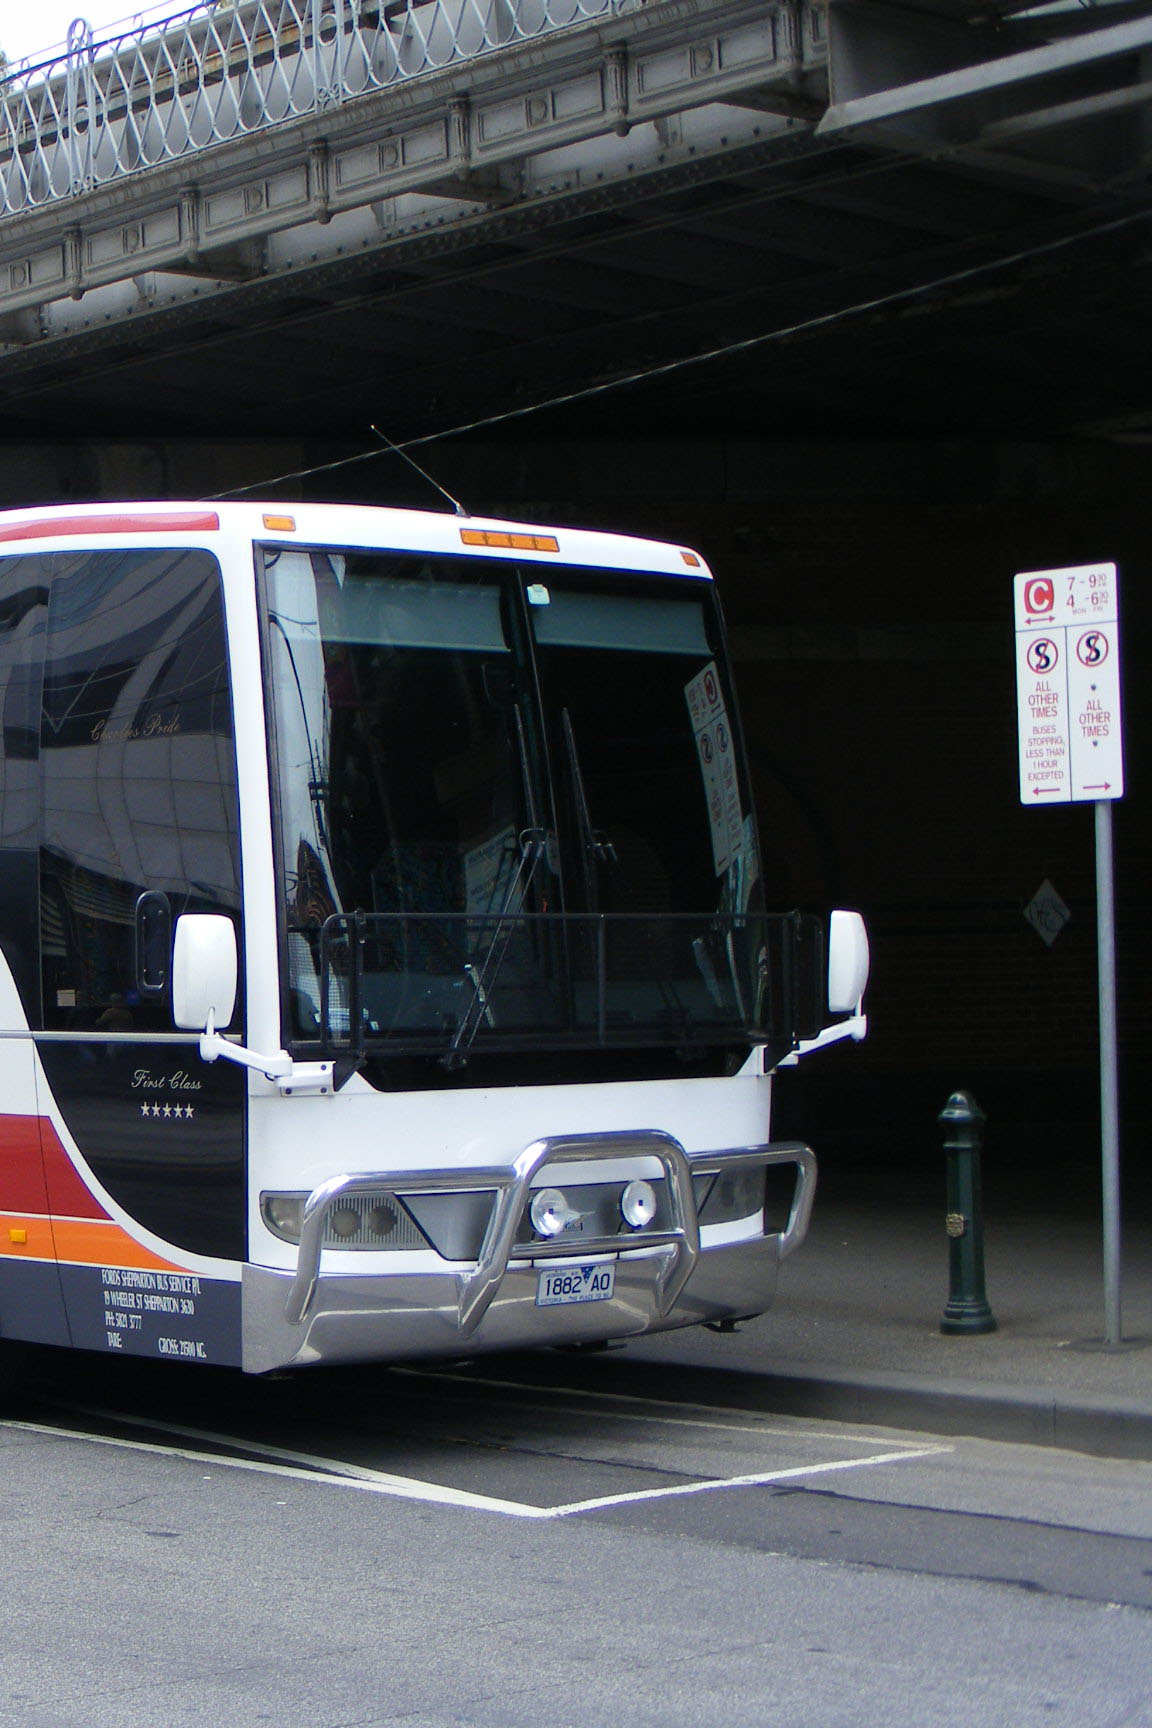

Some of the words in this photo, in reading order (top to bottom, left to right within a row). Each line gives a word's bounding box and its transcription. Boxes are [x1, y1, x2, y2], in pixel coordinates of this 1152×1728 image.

[1035, 681, 1052, 692] ALL
[1028, 693, 1059, 707] OTHER
[1086, 700, 1103, 711] ALL
[1031, 705, 1058, 719] TIMES
[1078, 711, 1111, 725] OTHER
[143, 713, 181, 736] Pride
[1032, 725, 1057, 735] BUSES
[1081, 725, 1110, 738] TIMES
[1026, 748, 1044, 758] LESS
[1046, 747, 1065, 757] THAN
[1037, 759, 1058, 769] HOUR
[1027, 770, 1064, 782] EXCEPTED
[131, 1069, 166, 1088] First
[168, 1070, 202, 1089] Class
[101, 1268, 121, 1286] FORDS
[121, 1270, 156, 1290] SHEPPARTON
[157, 1275, 168, 1292] BUS
[169, 1275, 191, 1294] SERVICE
[546, 1275, 582, 1296] 1882
[136, 1293, 143, 1309] ST
[143, 1294, 179, 1313] SHEPPARTON
[179, 1299, 195, 1315] 3630
